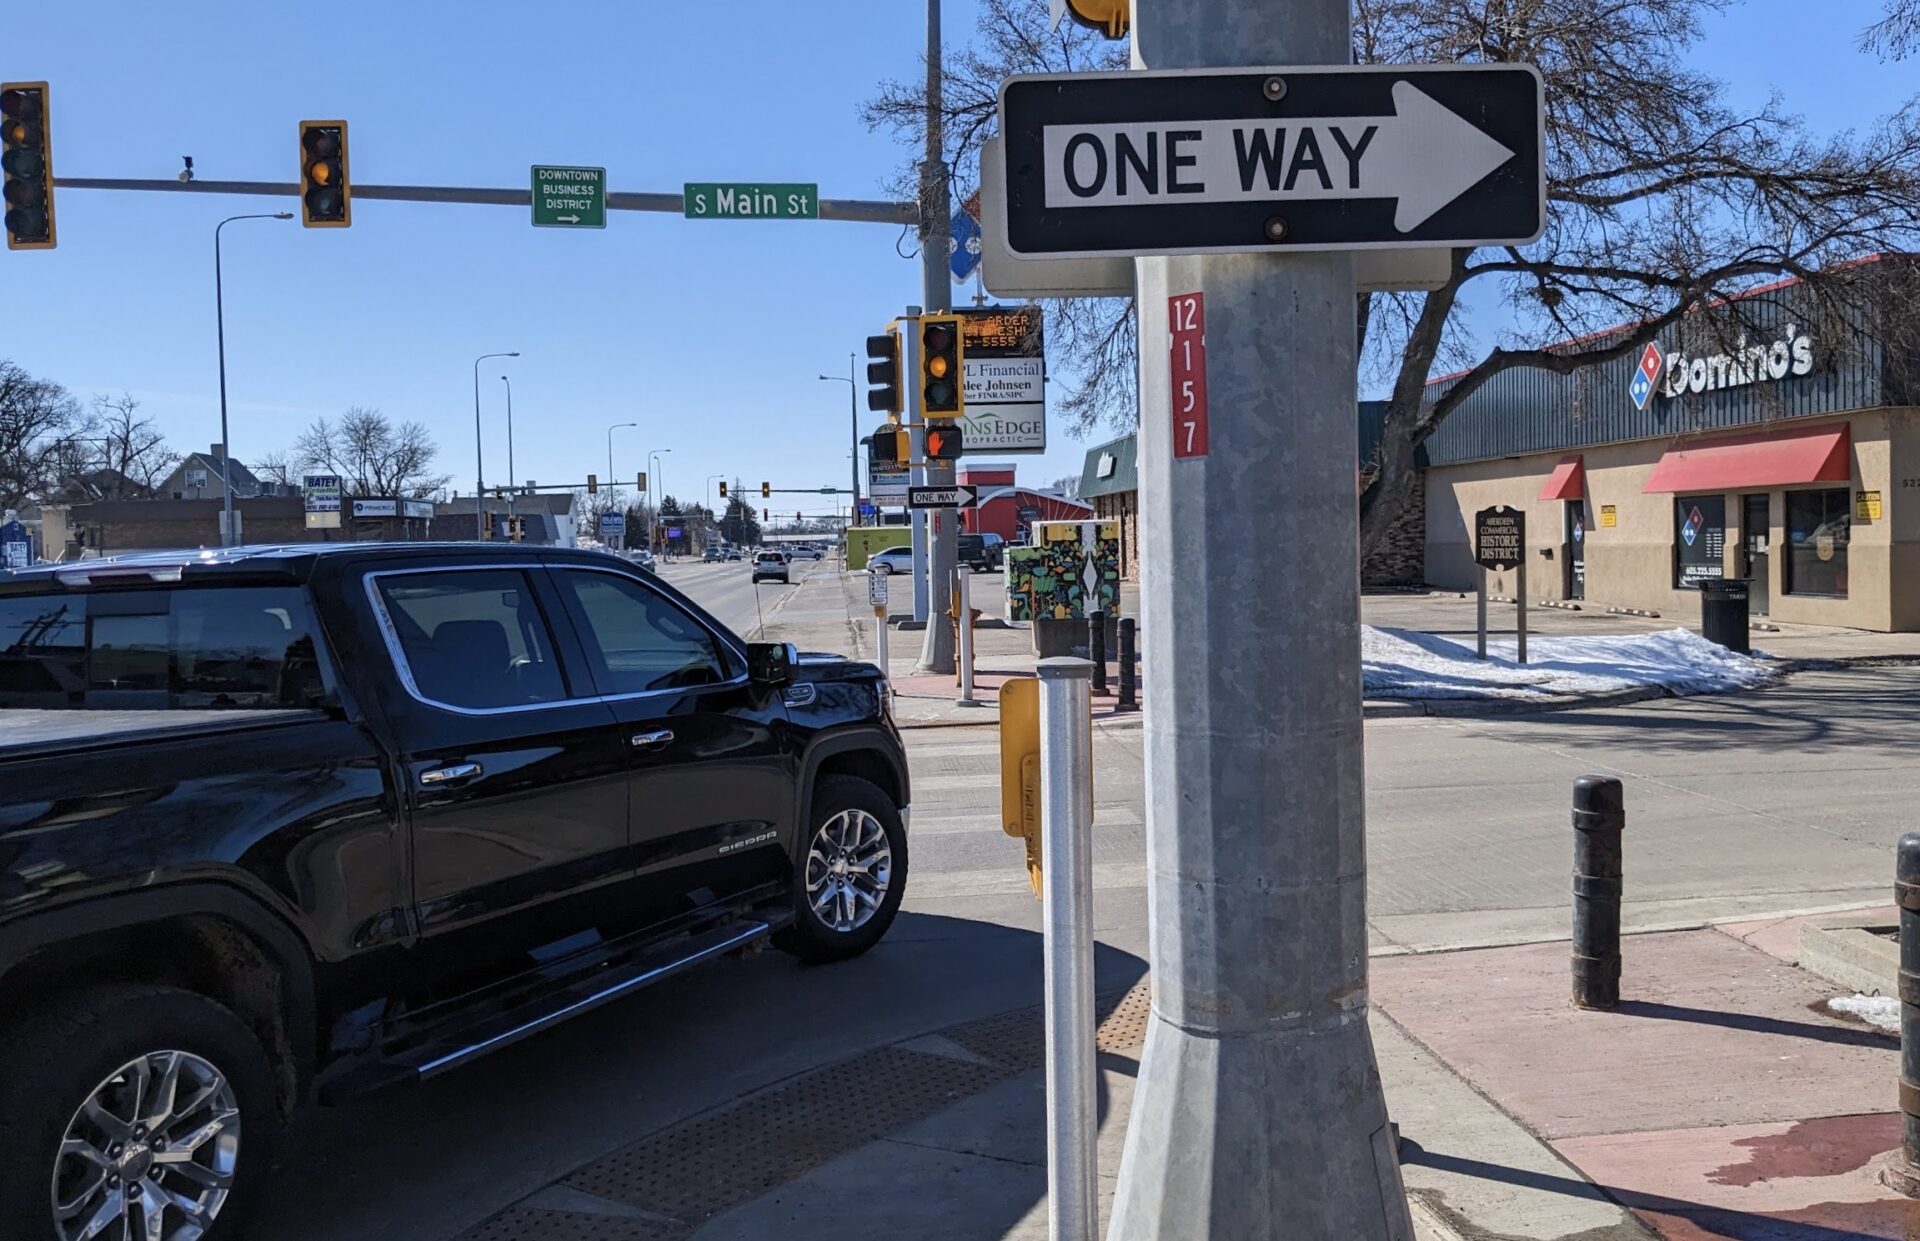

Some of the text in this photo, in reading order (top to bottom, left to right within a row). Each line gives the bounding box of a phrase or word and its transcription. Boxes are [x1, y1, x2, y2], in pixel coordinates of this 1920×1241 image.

[1063, 125, 1379, 198] ONE WAY
[539, 170, 598, 182] DOWNTOWN
[543, 184, 594, 196] BUSINESS
[546, 199, 591, 210] DISTRICT
[694, 188, 808, 215] S Main St
[1665, 322, 1813, 398] Domino's
[980, 363, 1039, 377] Financial
[986, 380, 1032, 391] Johnsen
[978, 391, 1025, 399] FINRA/SIPC
[308, 477, 337, 488] BATEY
[915, 492, 956, 503] ONE WAY
[1485, 517, 1515, 526] ABERDEEN
[1480, 526, 1519, 535] COMMERCIAL
[1480, 535, 1519, 547] HISTORIC
[1480, 547, 1520, 560] DISTRICT
[718, 831, 777, 853] SIERRA
